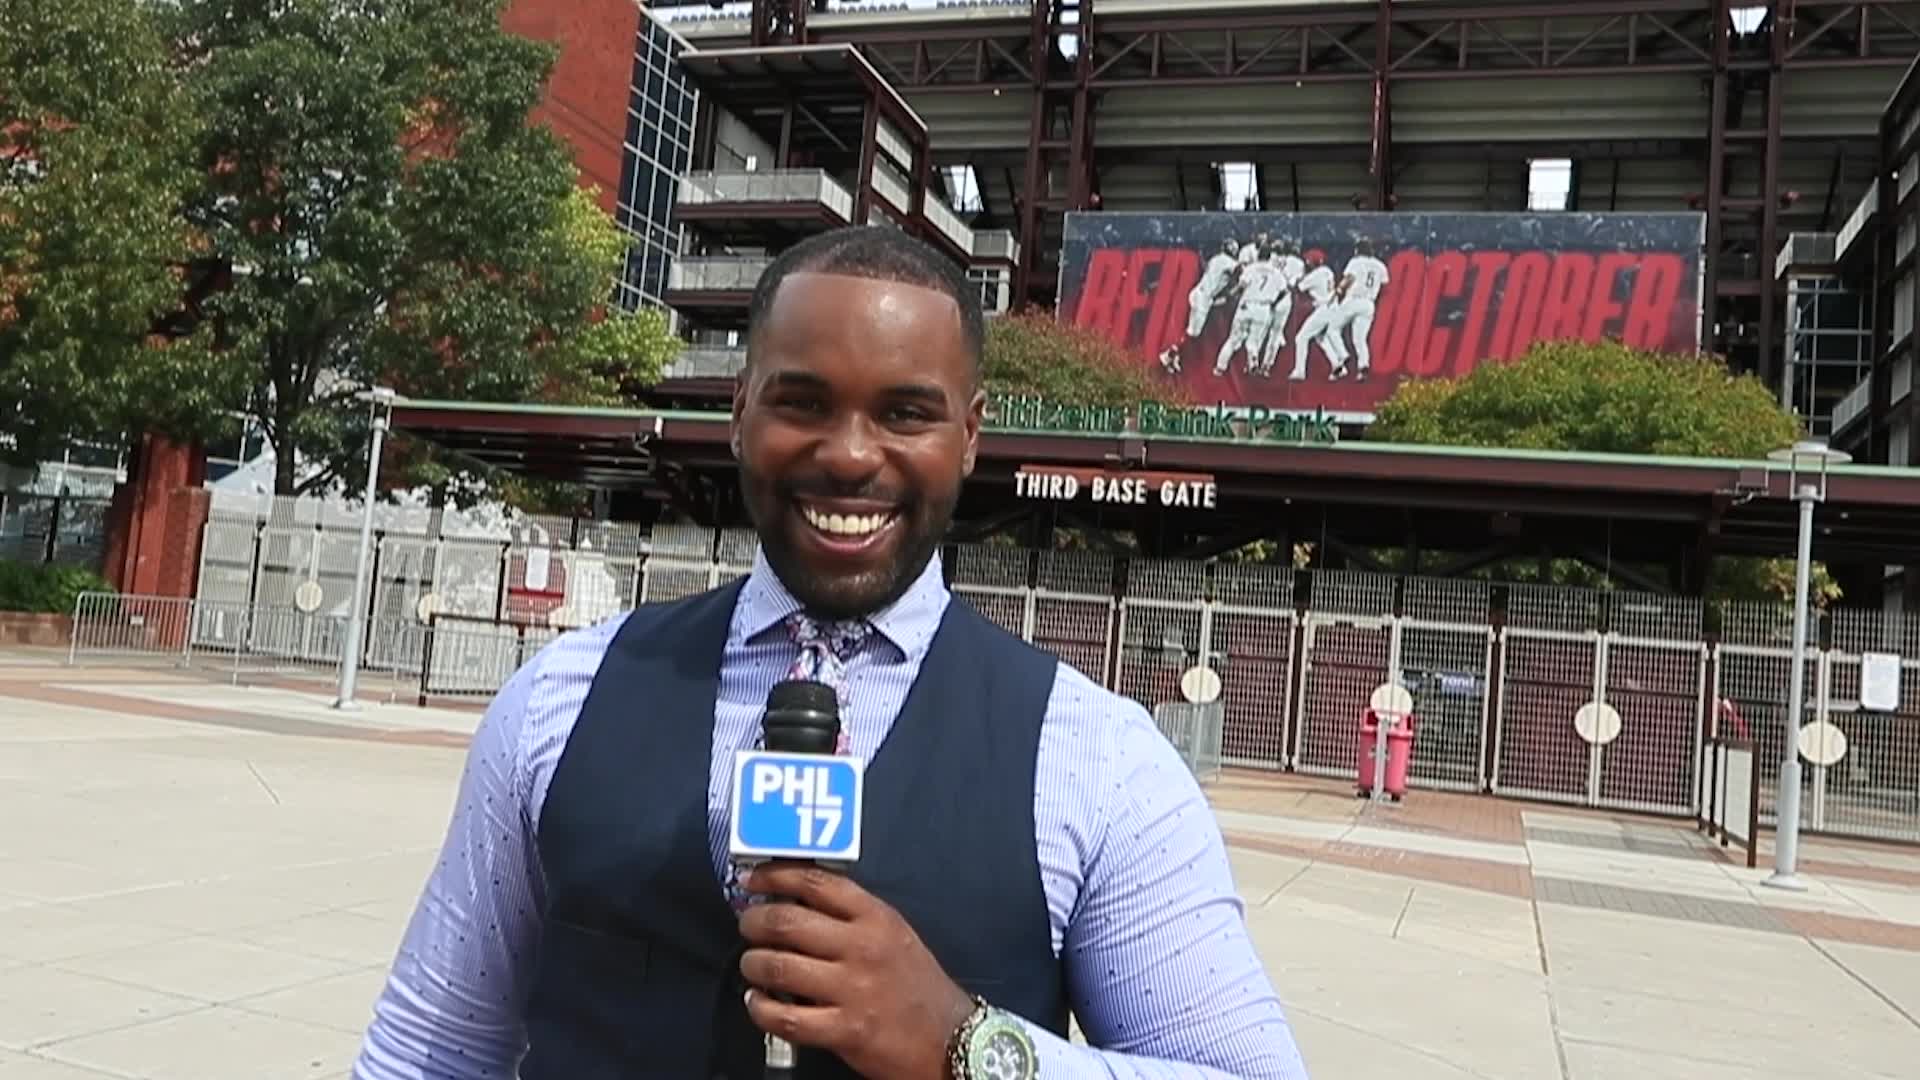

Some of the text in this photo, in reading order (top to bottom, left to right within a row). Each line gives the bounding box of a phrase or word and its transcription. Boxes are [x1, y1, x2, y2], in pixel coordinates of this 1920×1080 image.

[1260, 273, 1269, 291] 7
[1075, 247, 1684, 377] RED OCTOBER
[981, 394, 1341, 443] Citizens Bank Park
[1014, 471, 1216, 508] THIRD BASE GATE
[752, 763, 843, 806] PHL
[796, 807, 843, 847] 17
